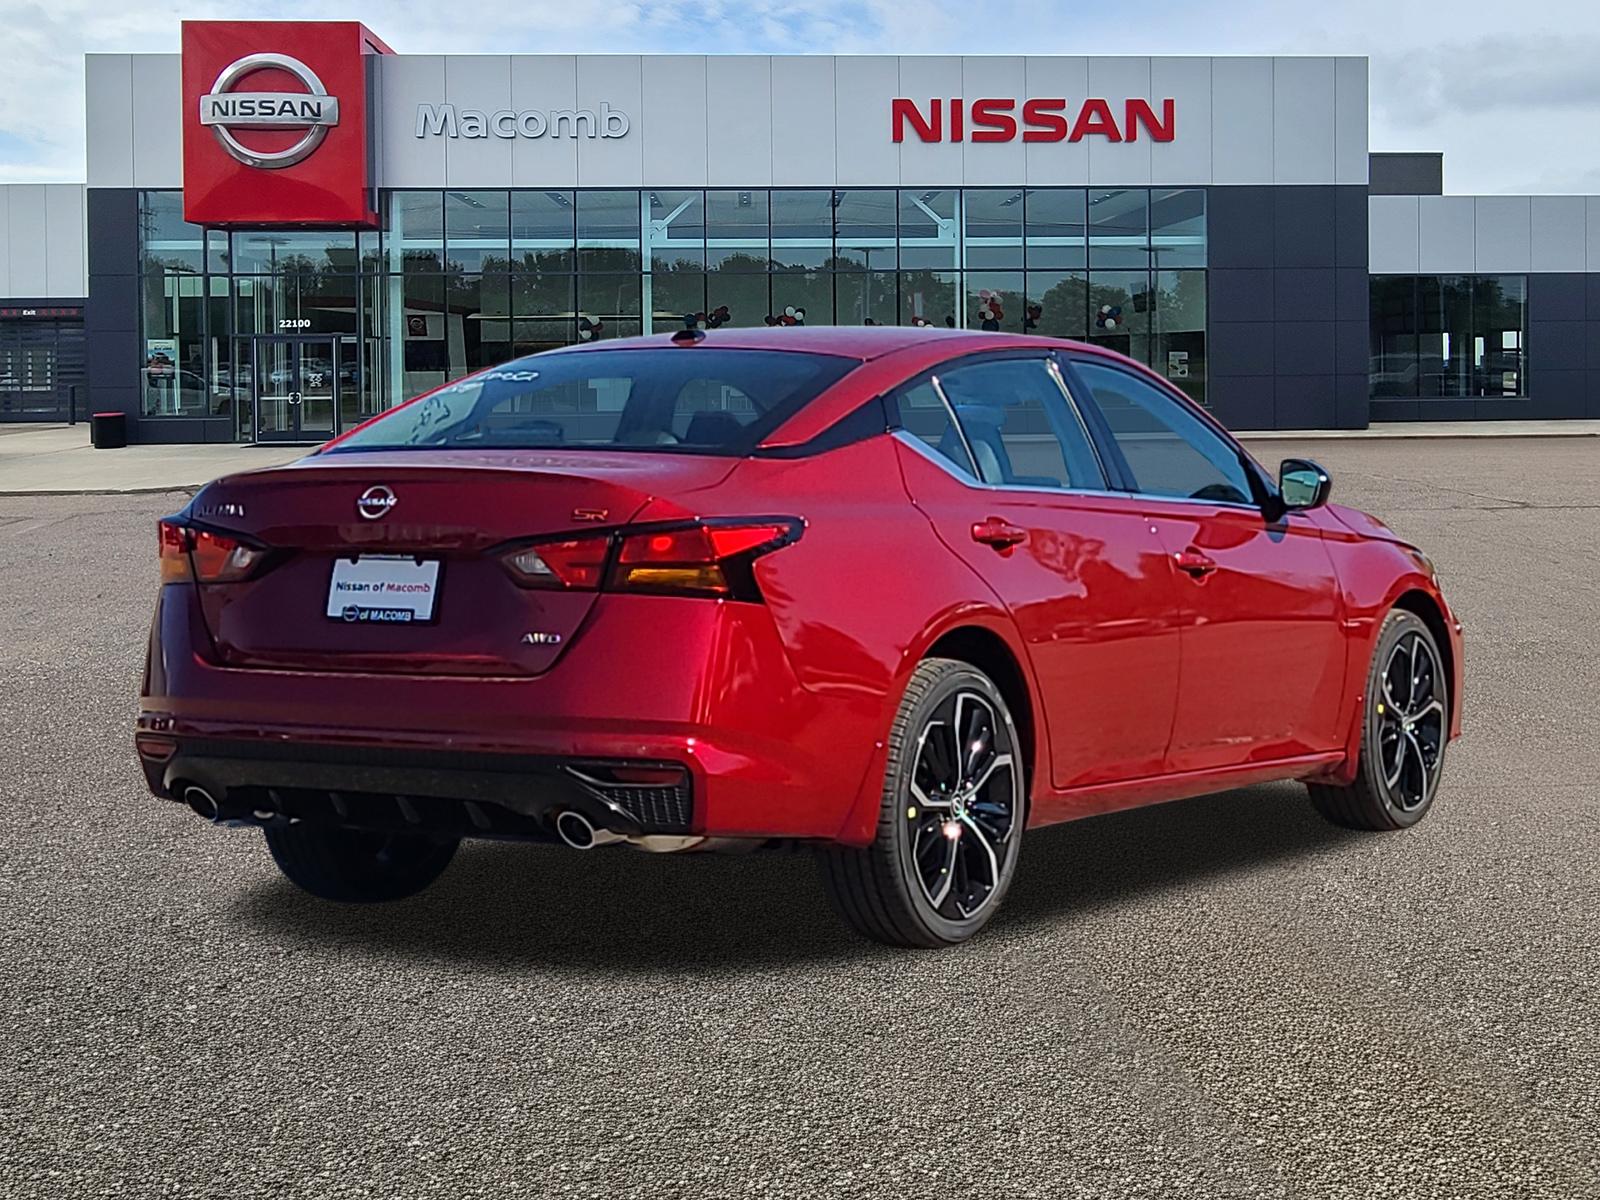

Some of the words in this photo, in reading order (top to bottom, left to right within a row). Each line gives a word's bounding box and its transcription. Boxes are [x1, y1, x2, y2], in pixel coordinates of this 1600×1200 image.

[211, 99, 322, 118] NISSAN
[414, 102, 630, 139] Macomb
[891, 98, 1176, 143] NISSAN
[279, 319, 311, 328] 22100
[574, 508, 608, 521] SR
[336, 581, 370, 592] Nissan
[372, 582, 384, 592] of
[386, 582, 431, 593] Macomb
[370, 610, 412, 621] MACOMB
[520, 632, 561, 644] AWD
